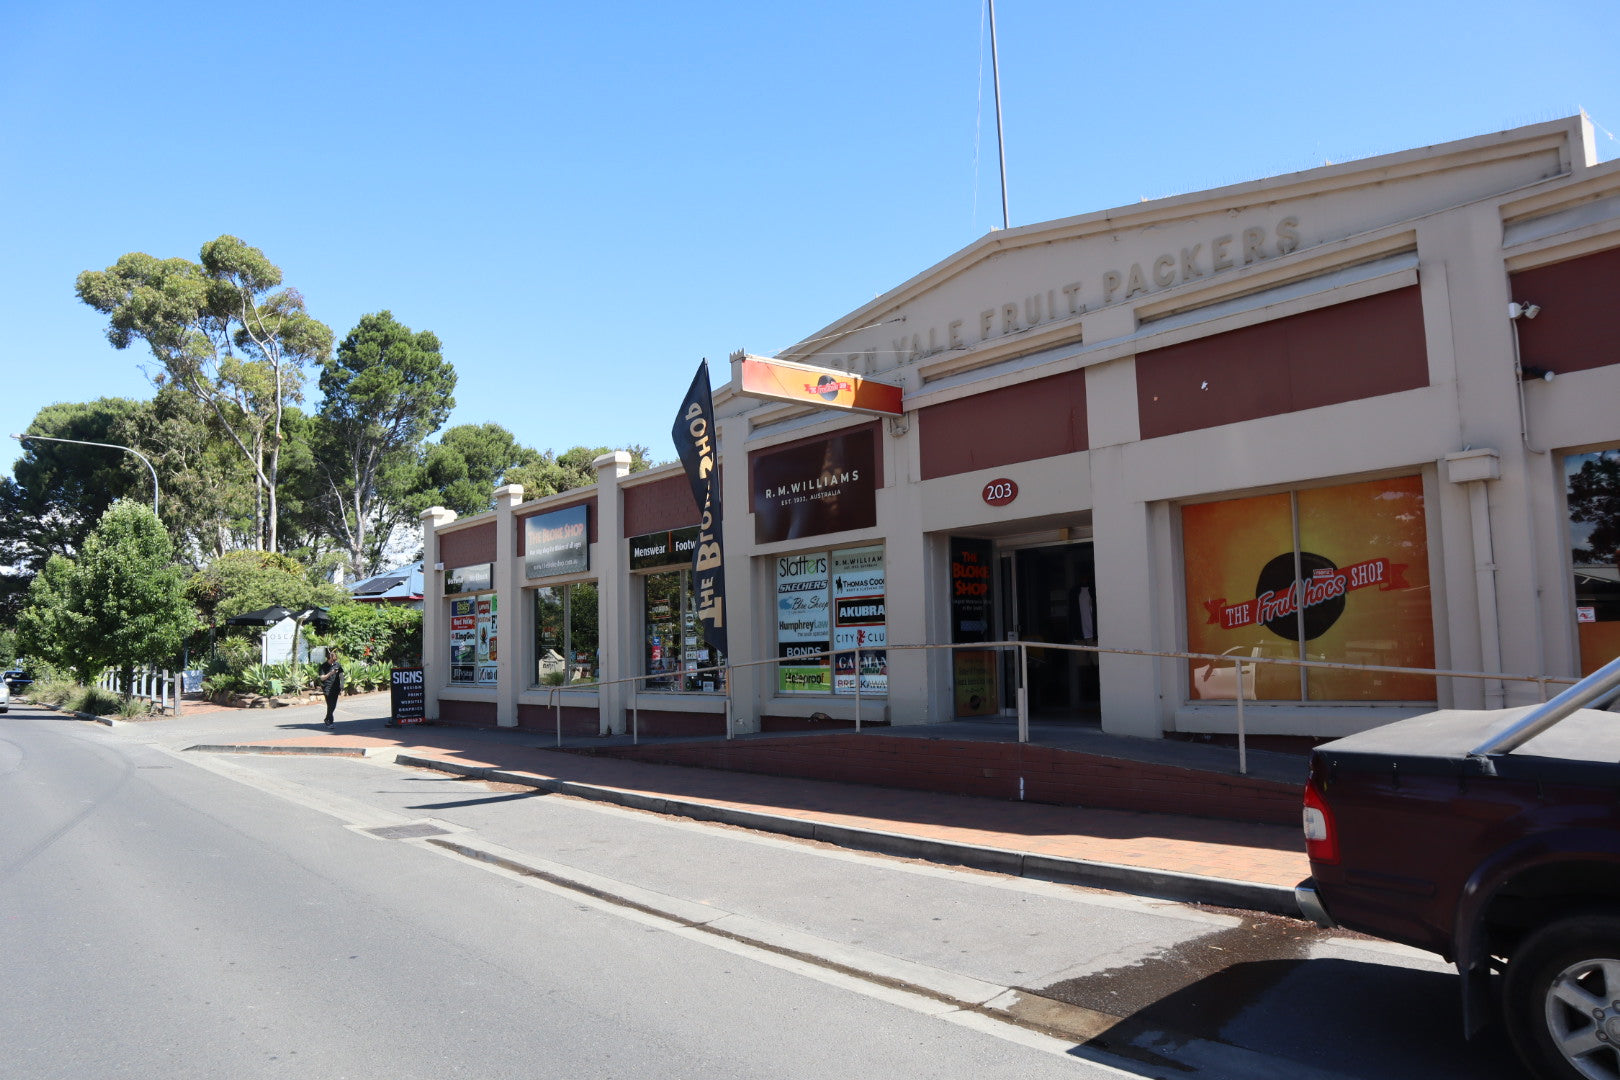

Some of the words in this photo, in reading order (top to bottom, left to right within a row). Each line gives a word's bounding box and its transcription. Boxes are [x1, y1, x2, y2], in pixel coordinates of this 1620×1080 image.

[892, 318, 964, 361] VALE
[980, 281, 1083, 341] FRUIT
[1102, 215, 1302, 305] PACKERS
[810, 489, 841, 501] AUSTRALIA
[986, 483, 1012, 500] 203
[564, 523, 584, 538] SHOP
[634, 544, 666, 559] Menswear
[675, 539, 697, 552] Footw
[779, 555, 827, 578] Slatters
[835, 556, 882, 566] R.M.WILLIAM
[953, 562, 990, 578] BLOKE
[778, 580, 828, 593] SKECHERS
[842, 580, 869, 588] THOMAS
[956, 580, 988, 596] SHOP
[1225, 604, 1250, 627] THE
[1255, 575, 1348, 626] FruChocs
[1351, 561, 1384, 587] SHOP
[839, 604, 886, 617] AKUBRA
[835, 634, 855, 643] CITY
[867, 633, 885, 642] CLU
[786, 647, 822, 660] BONDS
[838, 656, 888, 669] GAMAN
[393, 671, 423, 684] SIGNS
